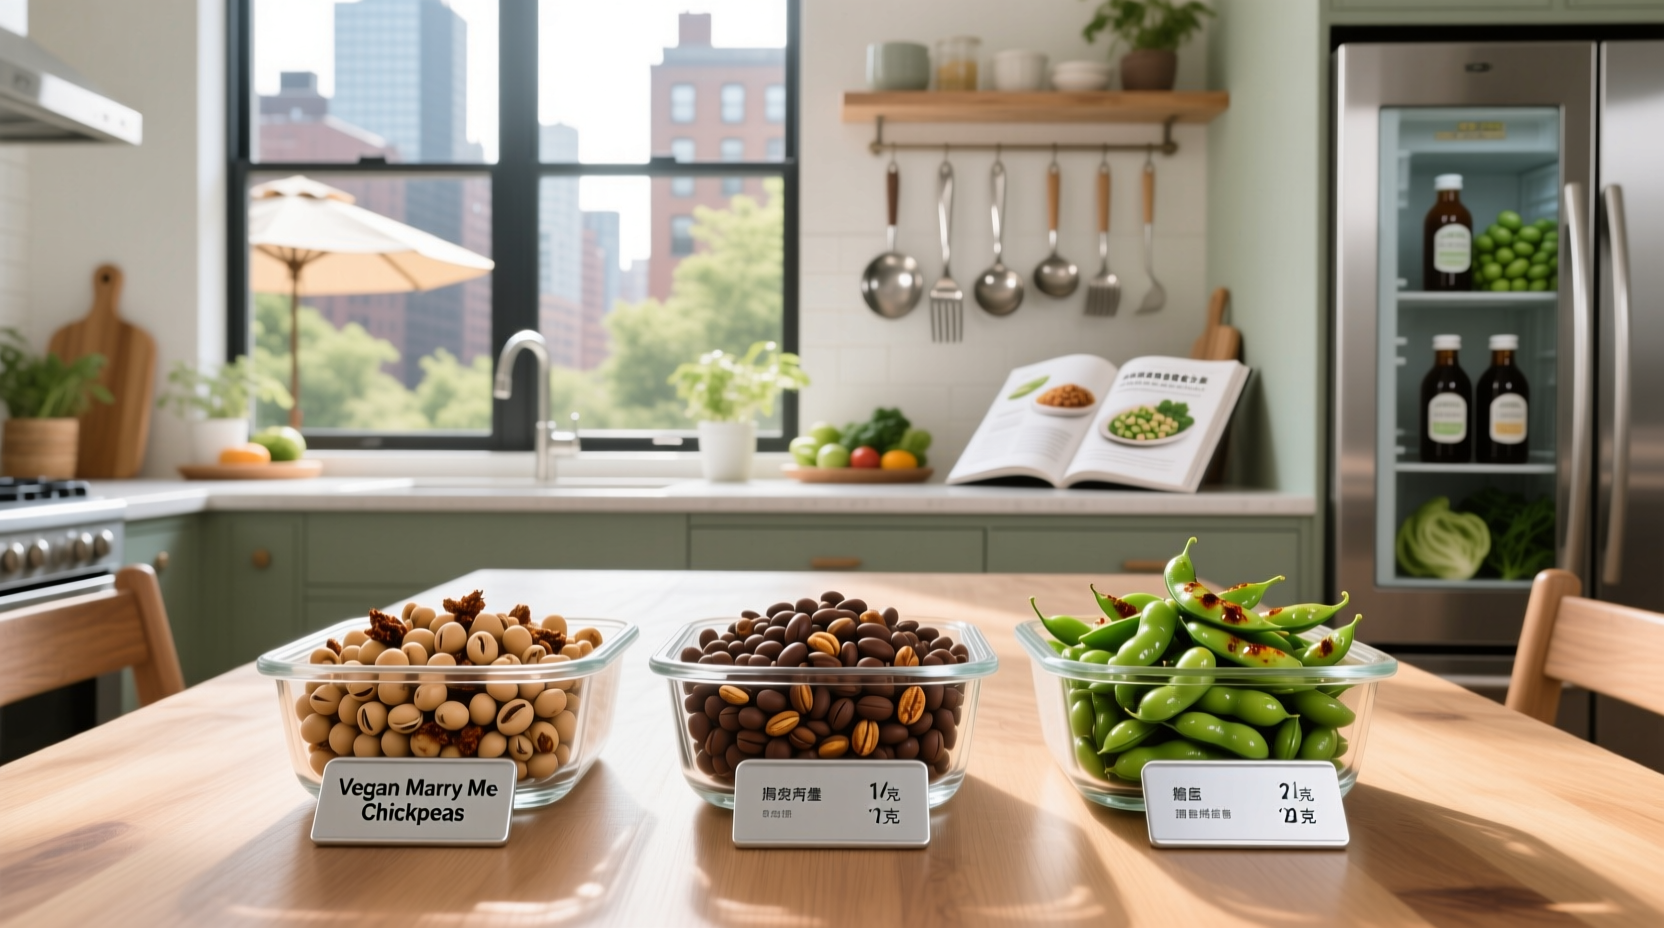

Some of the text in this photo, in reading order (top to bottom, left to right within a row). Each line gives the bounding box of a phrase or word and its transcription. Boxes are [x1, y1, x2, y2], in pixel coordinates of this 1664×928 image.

[339, 777, 499, 802] Vegan Marry Me
[361, 802, 465, 826] Chickpeas
